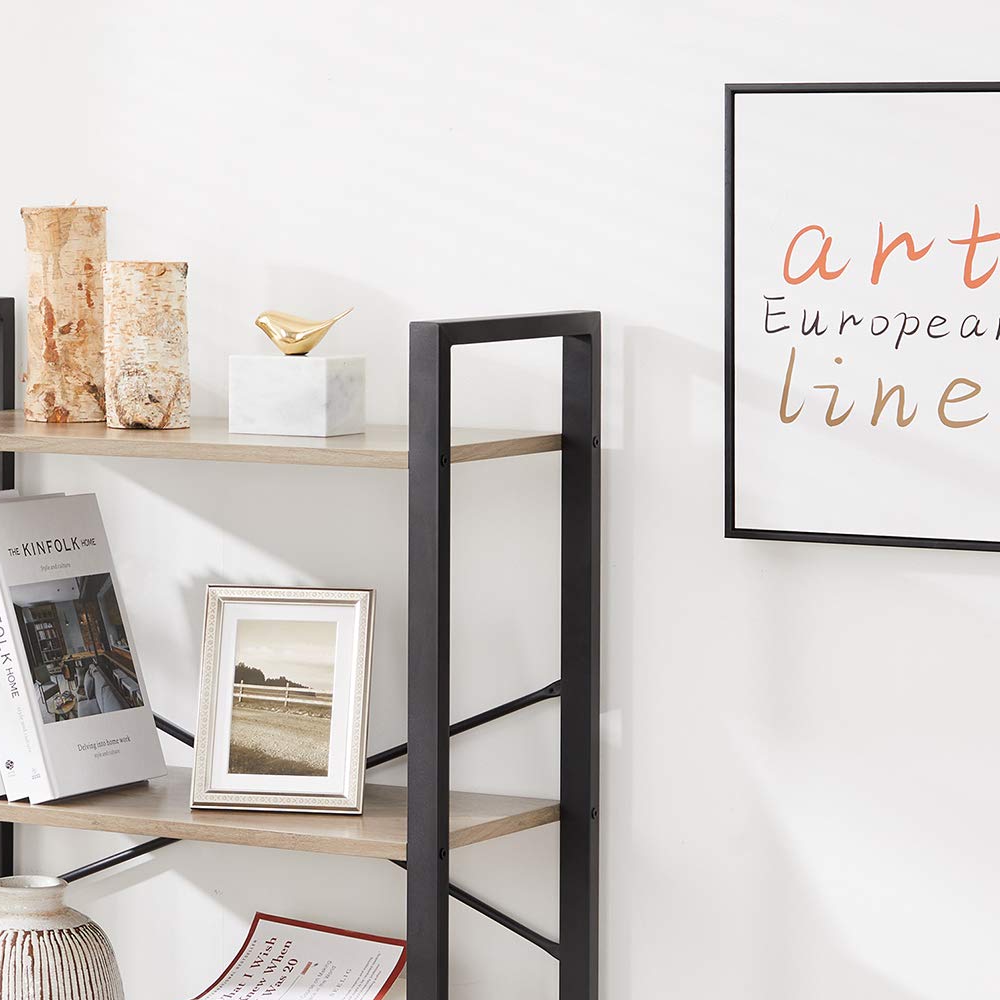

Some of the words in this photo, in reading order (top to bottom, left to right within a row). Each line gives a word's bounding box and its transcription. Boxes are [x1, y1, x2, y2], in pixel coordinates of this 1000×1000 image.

[784, 203, 1000, 289] art
[763, 294, 1000, 350] Europea
[780, 347, 989, 428] line
[8, 547, 20, 556] THE
[22, 537, 80, 556] KINFOLK
[81, 538, 96, 547] HOME
[6, 667, 20, 700] HOME
[250, 937, 278, 968] Wish
[263, 940, 293, 974] When
[262, 975, 287, 996] Was
[282, 958, 298, 973] 20
